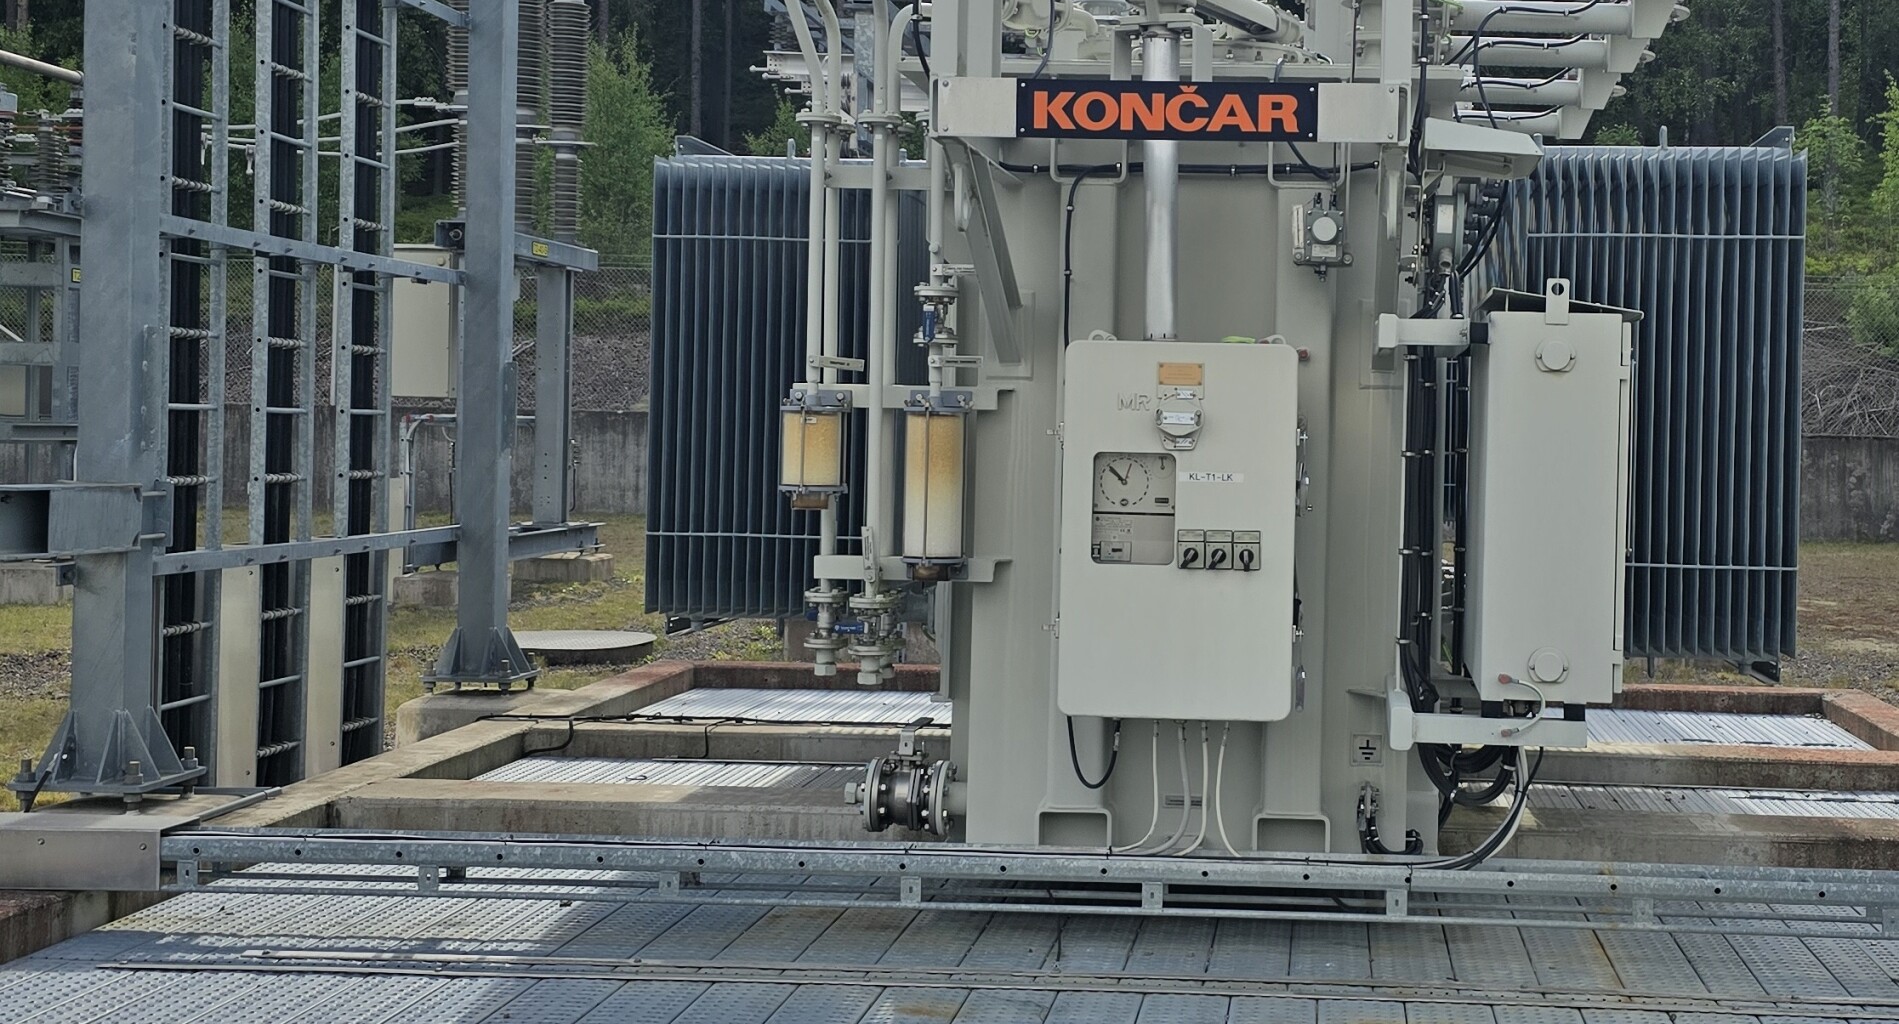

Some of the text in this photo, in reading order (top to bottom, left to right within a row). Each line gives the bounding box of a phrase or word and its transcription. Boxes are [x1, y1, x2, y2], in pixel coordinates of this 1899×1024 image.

[1033, 85, 1299, 133] KONČAR
[1117, 392, 1151, 411] MR
[1188, 472, 1234, 482] KL-T1-LK
